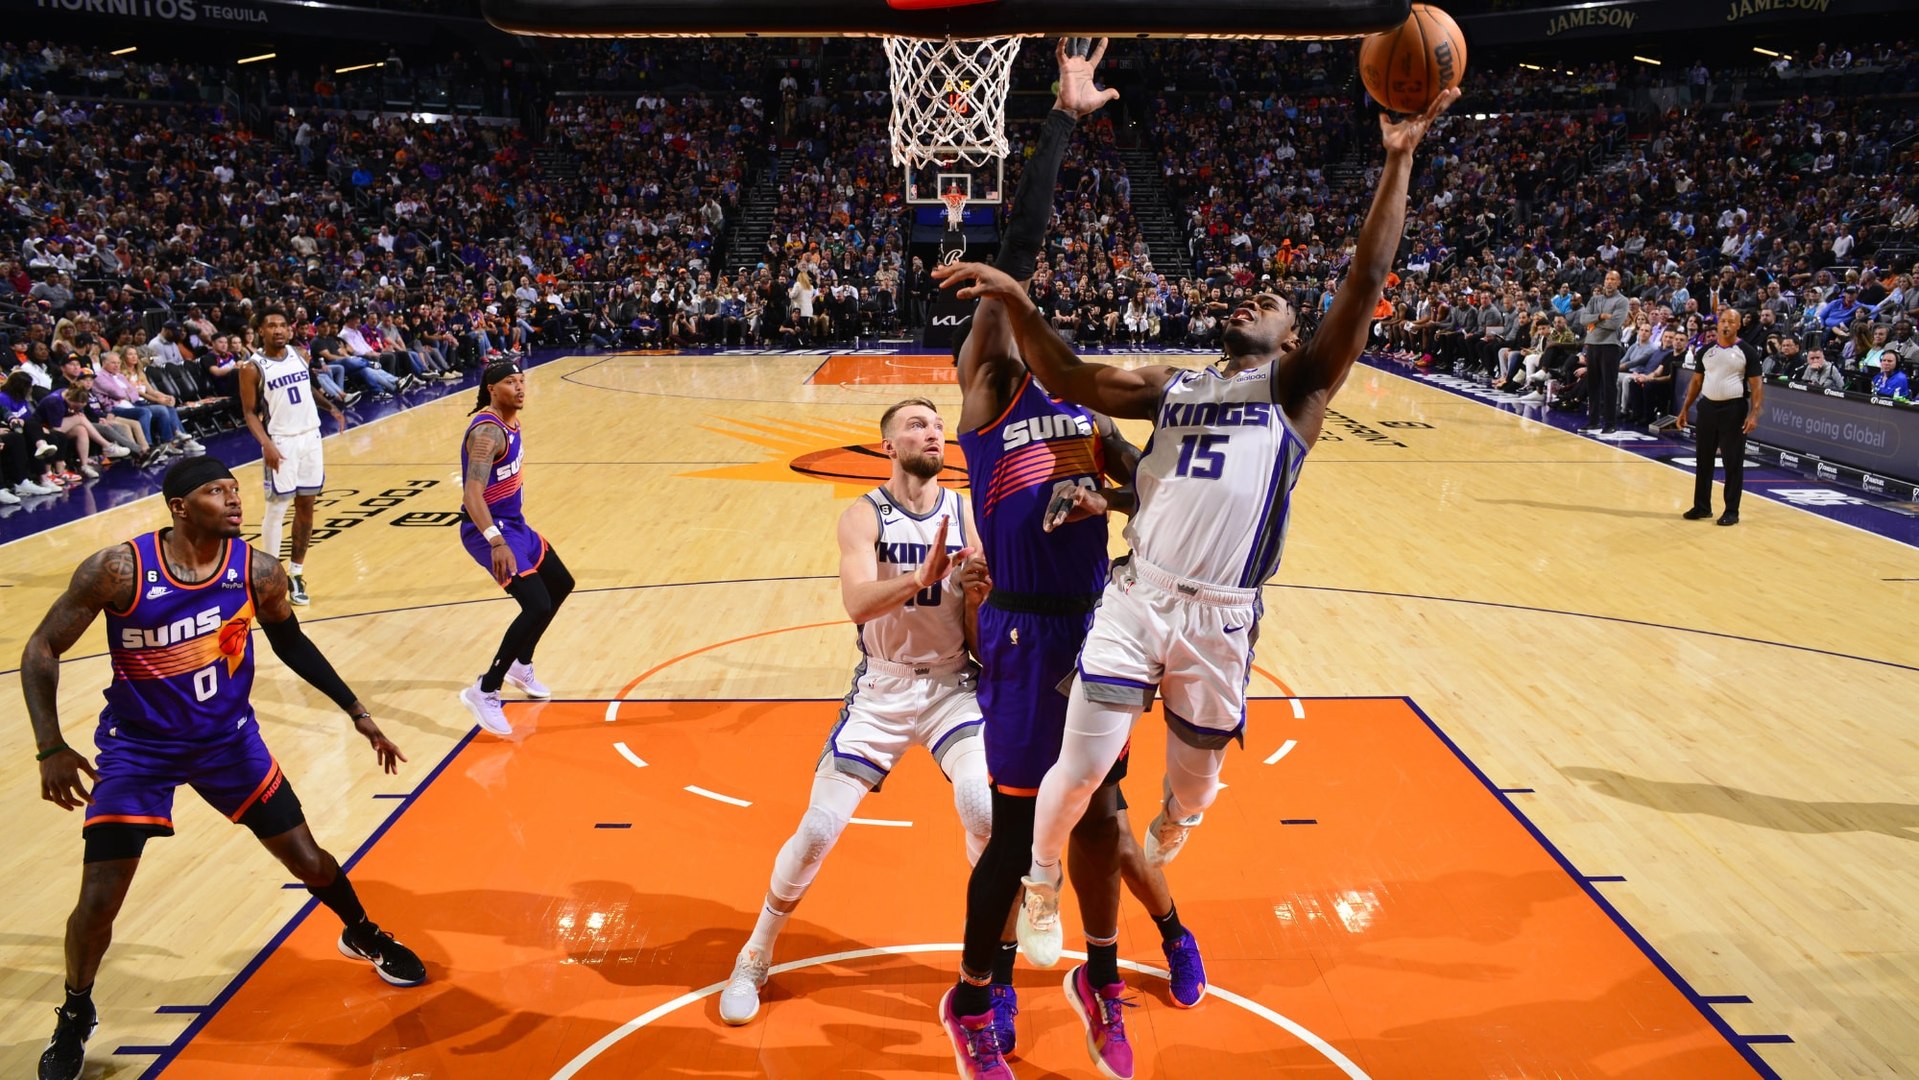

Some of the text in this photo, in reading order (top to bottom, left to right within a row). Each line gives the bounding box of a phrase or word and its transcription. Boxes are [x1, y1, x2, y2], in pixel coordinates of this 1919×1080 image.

[202, 5, 269, 23] TEQUILA
[1546, 7, 1636, 36] JAMESON
[267, 370, 309, 391] KINGS
[287, 386, 302, 405] 0
[1161, 401, 1272, 429] KINGS
[1772, 406, 1887, 448] We're going Global
[1003, 413, 1093, 451] SUNS
[1175, 434, 1230, 480] 15
[876, 541, 963, 564] KIN
[147, 570, 158, 582] 6
[122, 605, 222, 649] SUNS
[193, 665, 218, 702] 0
